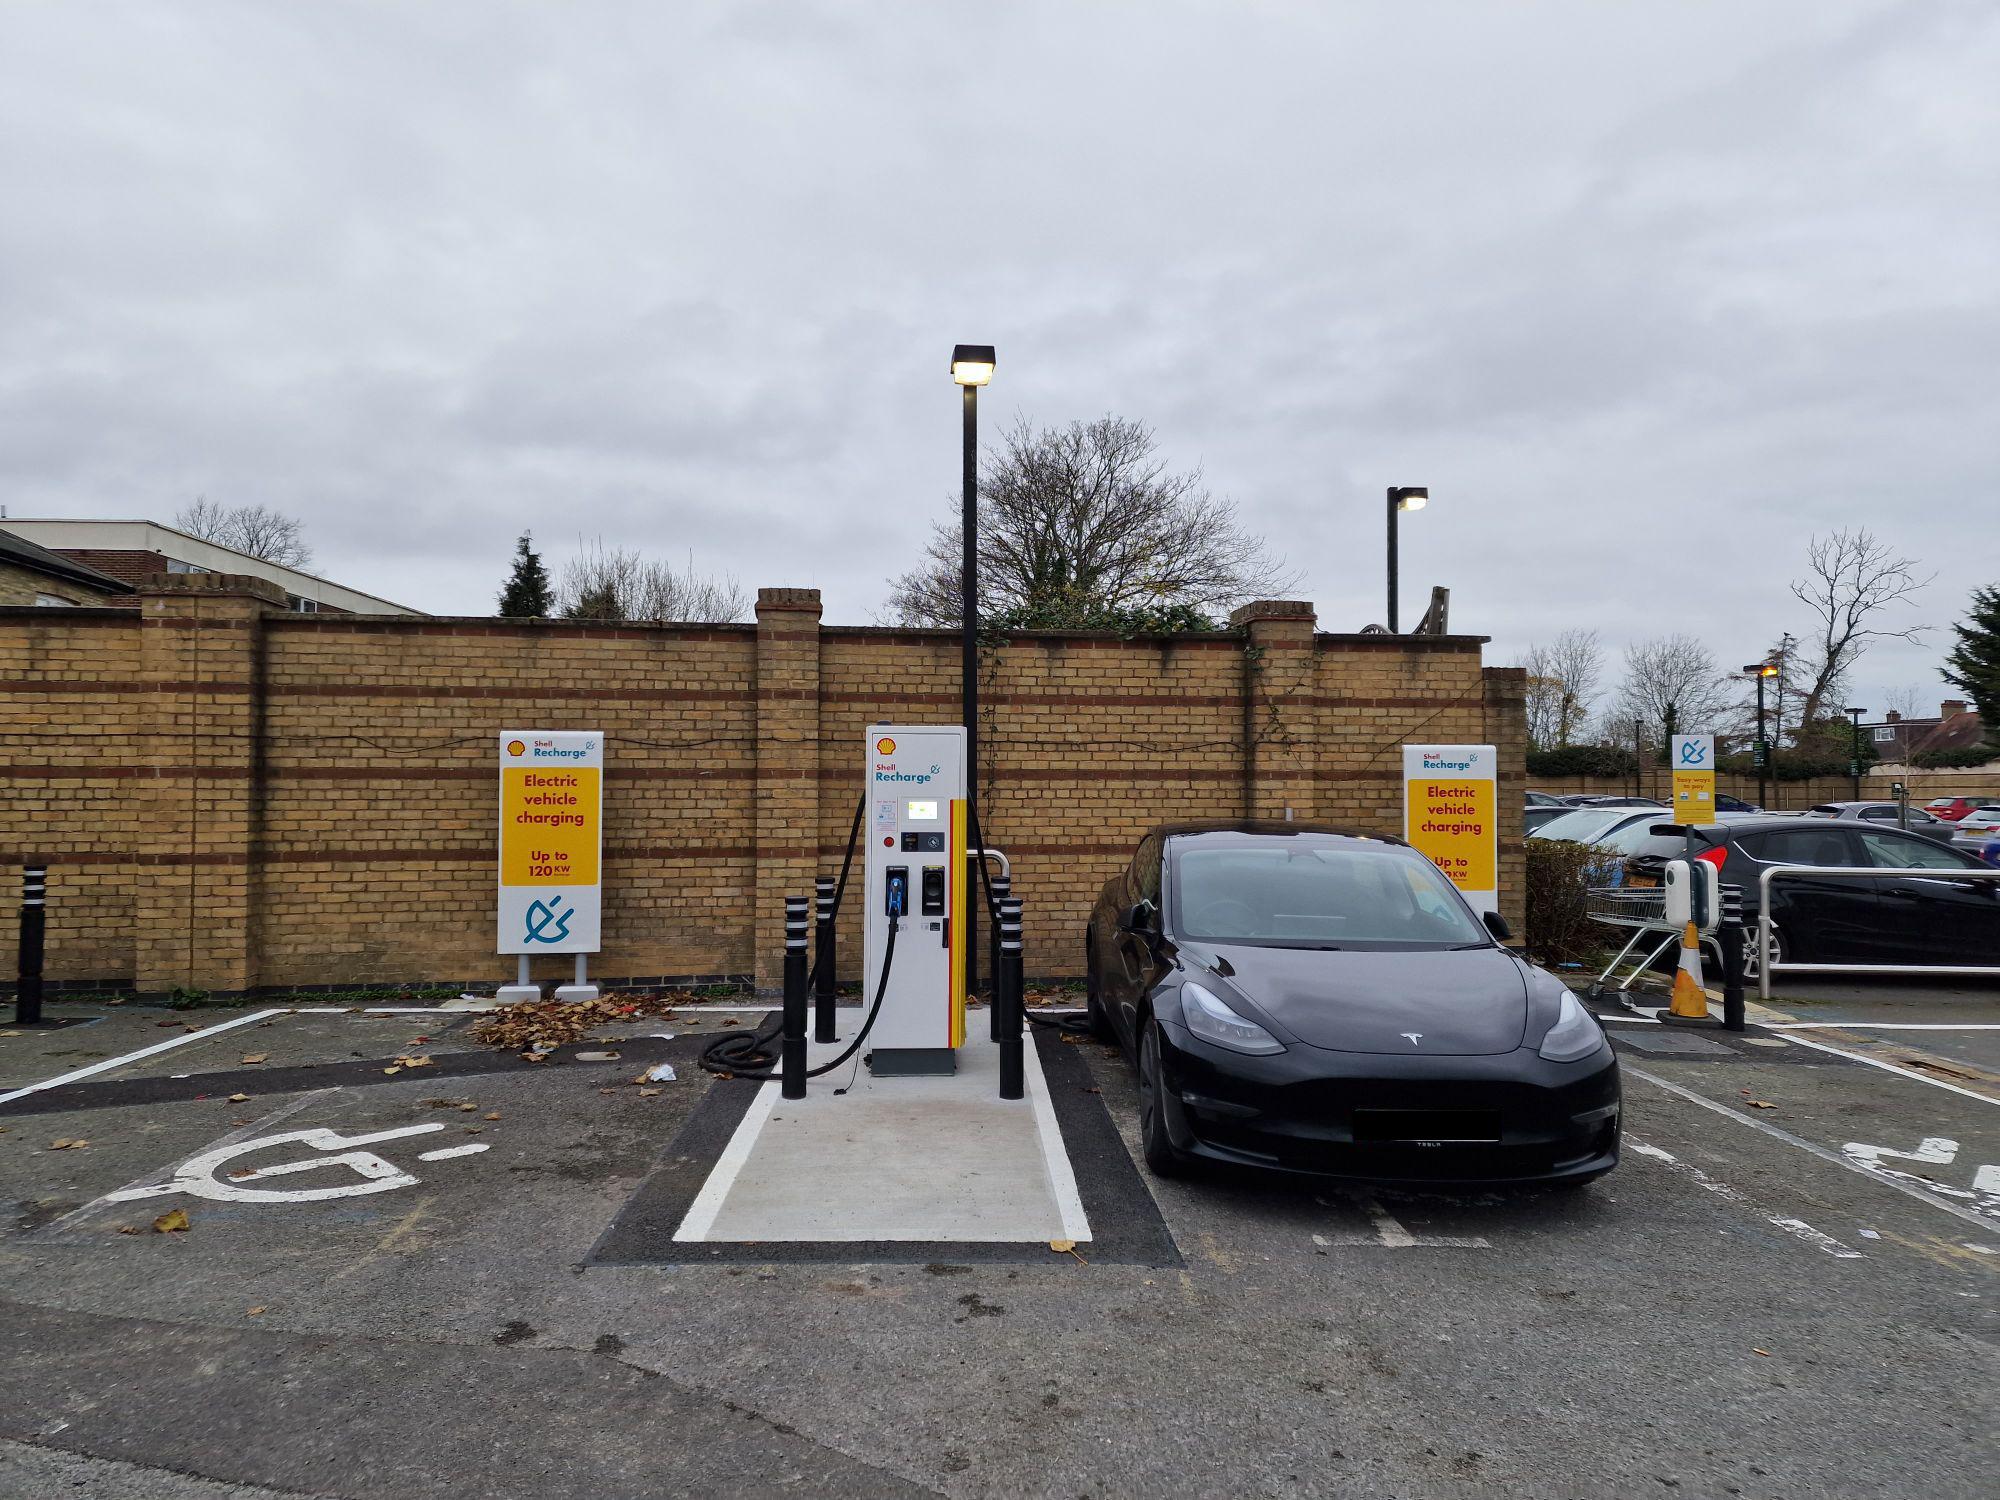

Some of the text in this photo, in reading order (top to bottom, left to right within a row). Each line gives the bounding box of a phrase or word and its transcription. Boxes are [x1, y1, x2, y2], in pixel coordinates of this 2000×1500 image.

[534, 748, 586, 759] Recharge
[876, 763, 896, 771] Shell
[1423, 760, 1470, 771] Recharge
[524, 774, 578, 787] Electric
[876, 771, 931, 784] Recharge
[1427, 786, 1476, 797] Electric
[524, 792, 577, 805] vehicle
[1427, 802, 1475, 815] vehicle
[516, 810, 584, 827] charging
[1421, 820, 1482, 835] charging
[531, 850, 568, 864] Up to
[1434, 856, 1468, 869] Up to
[528, 865, 553, 877] 120
